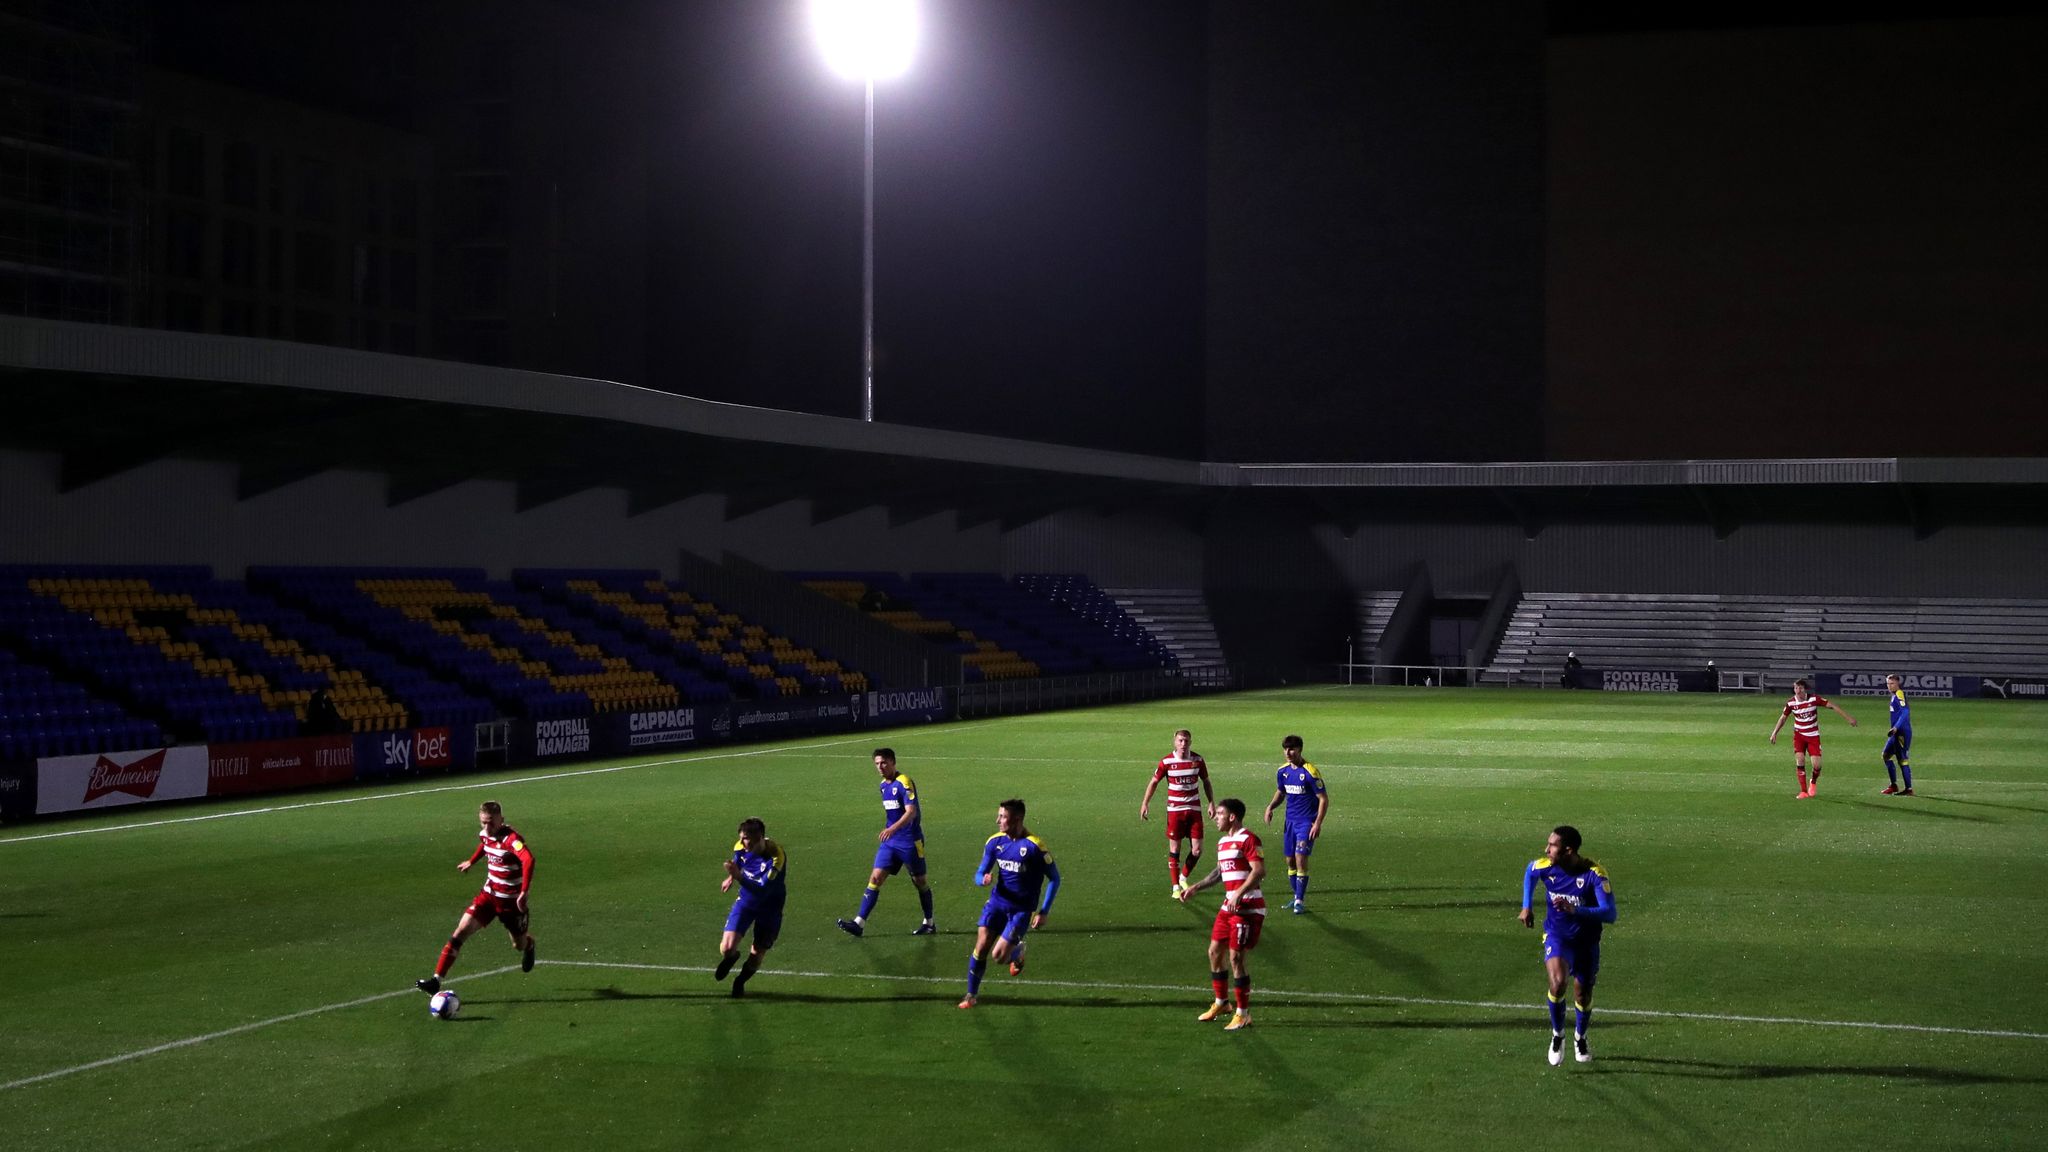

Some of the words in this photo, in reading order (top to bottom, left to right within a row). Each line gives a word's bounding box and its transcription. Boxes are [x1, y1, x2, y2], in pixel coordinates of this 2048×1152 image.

[1603, 671, 1679, 682] FOOTBALL
[1603, 682, 1679, 692] MANAGER
[2011, 683, 2046, 695] PUMA
[879, 691, 935, 712] BUCKINGHAM
[536, 718, 590, 739] FOOTBALL
[630, 708, 694, 732] CAPPAGH
[384, 733, 411, 770] sky
[416, 732, 447, 761] bet
[536, 736, 590, 756] MANAGER
[0, 777, 21, 792] Injury
[89, 764, 160, 791] Budweiser
